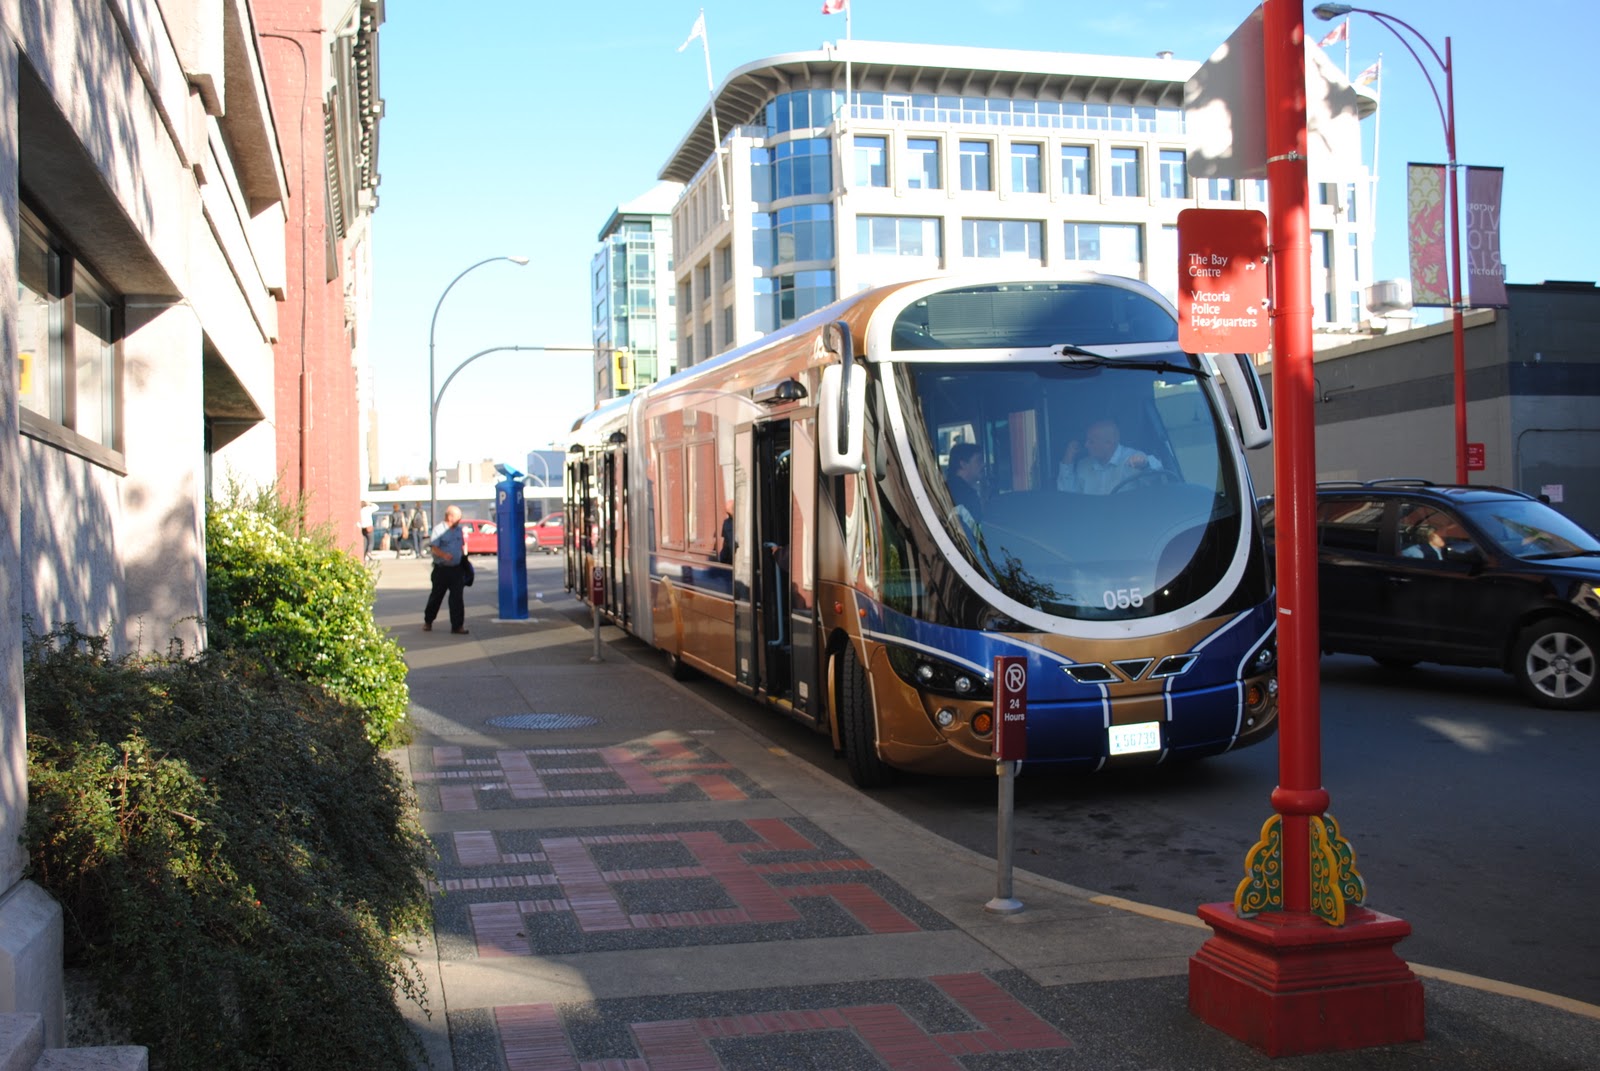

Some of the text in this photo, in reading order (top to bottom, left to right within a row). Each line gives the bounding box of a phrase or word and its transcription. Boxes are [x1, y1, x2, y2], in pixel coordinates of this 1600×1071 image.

[1189, 254, 1228, 267] The Bay
[1189, 265, 1221, 277] Centre
[1191, 291, 1231, 302] Victoria
[1191, 304, 1220, 315] Police
[1191, 317, 1257, 329] Headquarters
[1103, 587, 1144, 611] 055
[1009, 699, 1020, 709] 24
[1004, 713, 1025, 722] Hours
